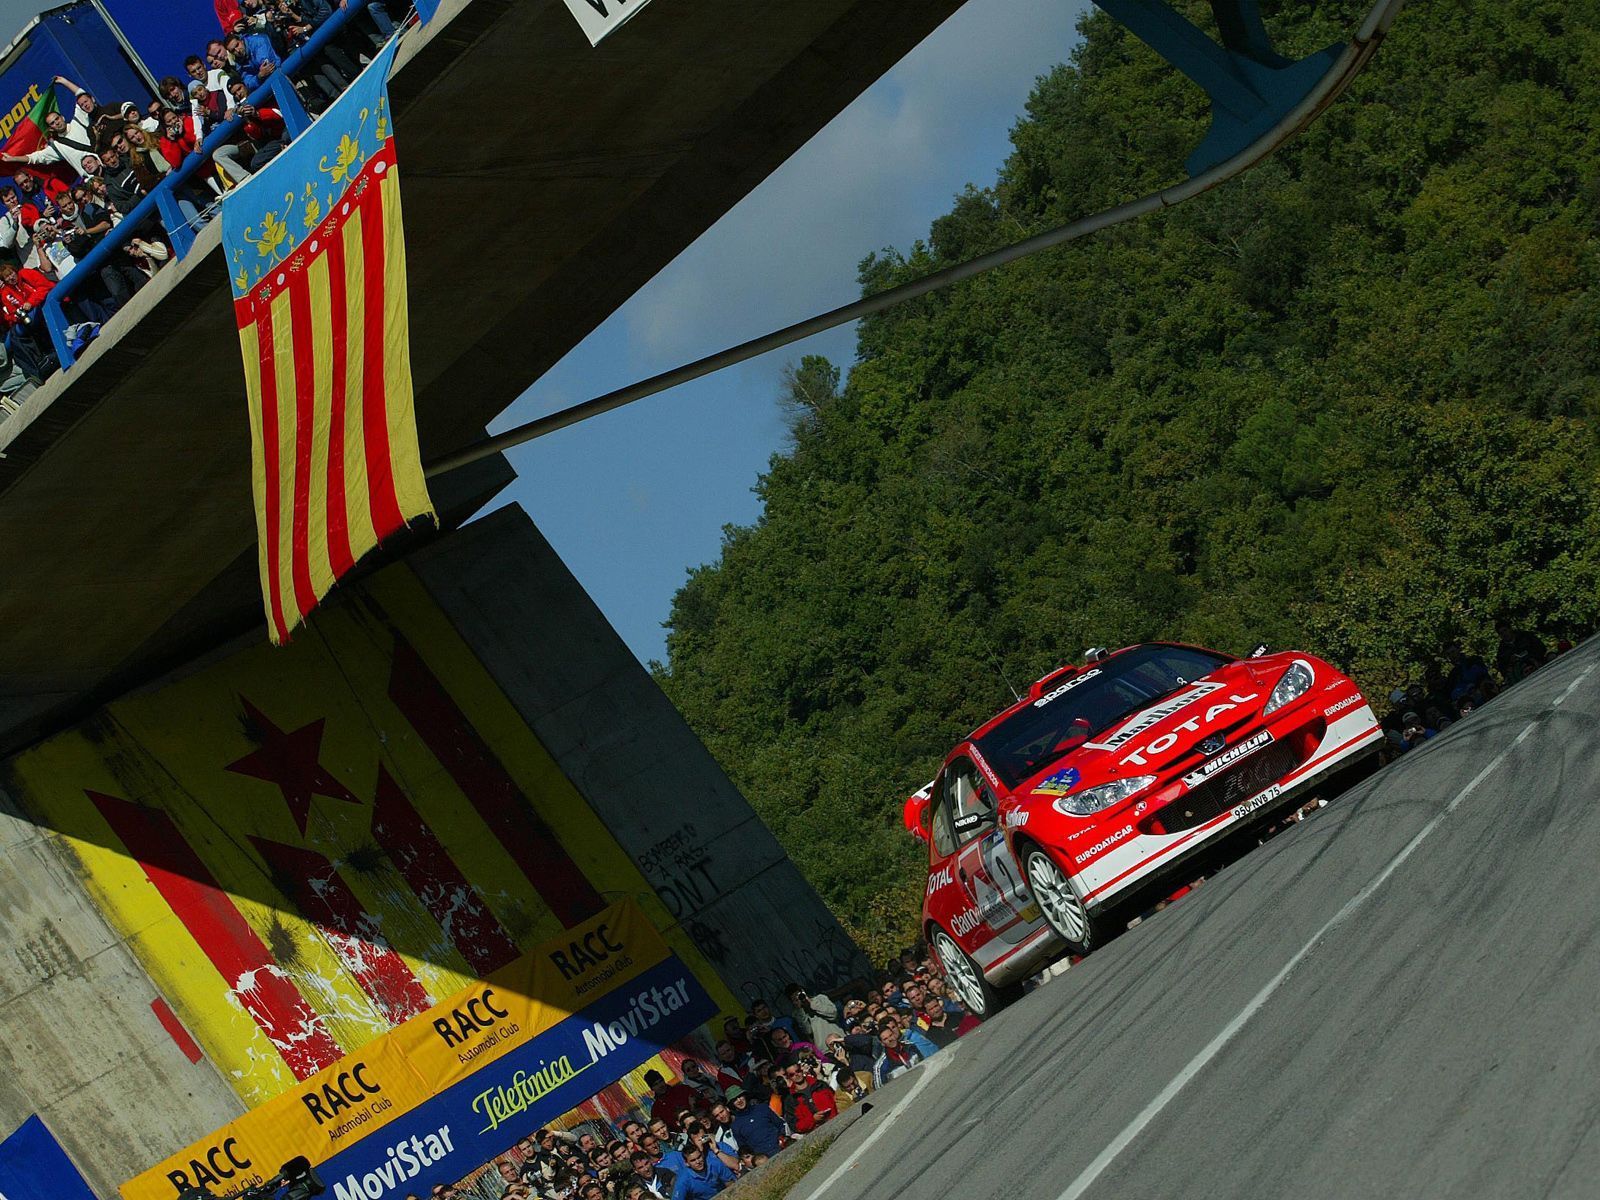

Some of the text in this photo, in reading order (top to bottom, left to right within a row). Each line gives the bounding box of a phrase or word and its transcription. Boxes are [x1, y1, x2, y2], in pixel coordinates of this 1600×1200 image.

[0, 84, 42, 139] port
[1034, 669, 1103, 708] sparco
[1107, 686, 1215, 746] Marlboro
[1119, 693, 1258, 766] TOTAL
[1204, 731, 1269, 774] MICHELIN
[1269, 787, 1280, 798] 75
[1075, 825, 1133, 864] EURODATACAR
[926, 864, 953, 896] TOTAL
[995, 856, 1029, 902] 2
[549, 924, 624, 981] RACC
[432, 989, 509, 1048] RACC
[499, 1022, 520, 1039] Club
[582, 977, 691, 1063] MoviStar
[301, 1062, 381, 1125] RACC
[370, 1096, 393, 1114] Club
[166, 1137, 252, 1195] RACC
[333, 1124, 454, 1200] MoviStar
